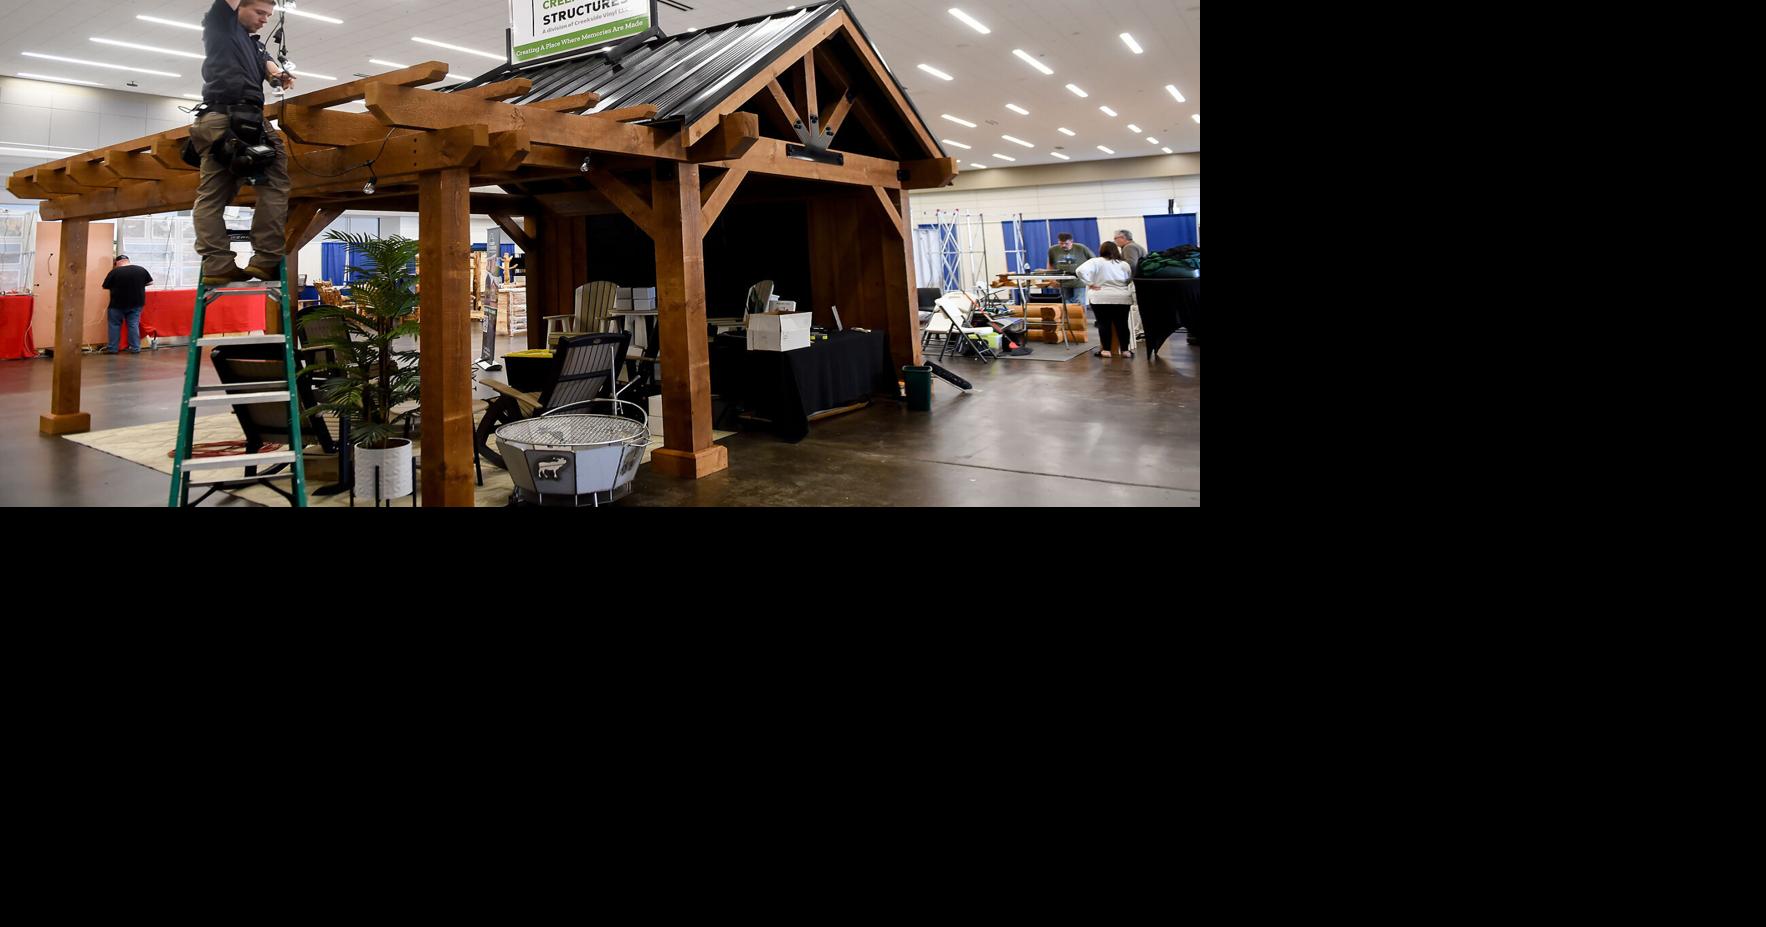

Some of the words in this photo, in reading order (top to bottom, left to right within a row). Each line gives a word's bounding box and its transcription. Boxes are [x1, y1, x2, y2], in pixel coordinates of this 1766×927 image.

[547, 24, 567, 32] division
[575, 14, 602, 25] Creekside
[603, 9, 618, 17] Vinyl
[516, 46, 540, 56] Creating
[545, 41, 561, 49] Place
[561, 37, 581, 45] Where
[581, 29, 611, 41] Memories
[612, 25, 624, 33] Are
[625, 20, 643, 29] Made
